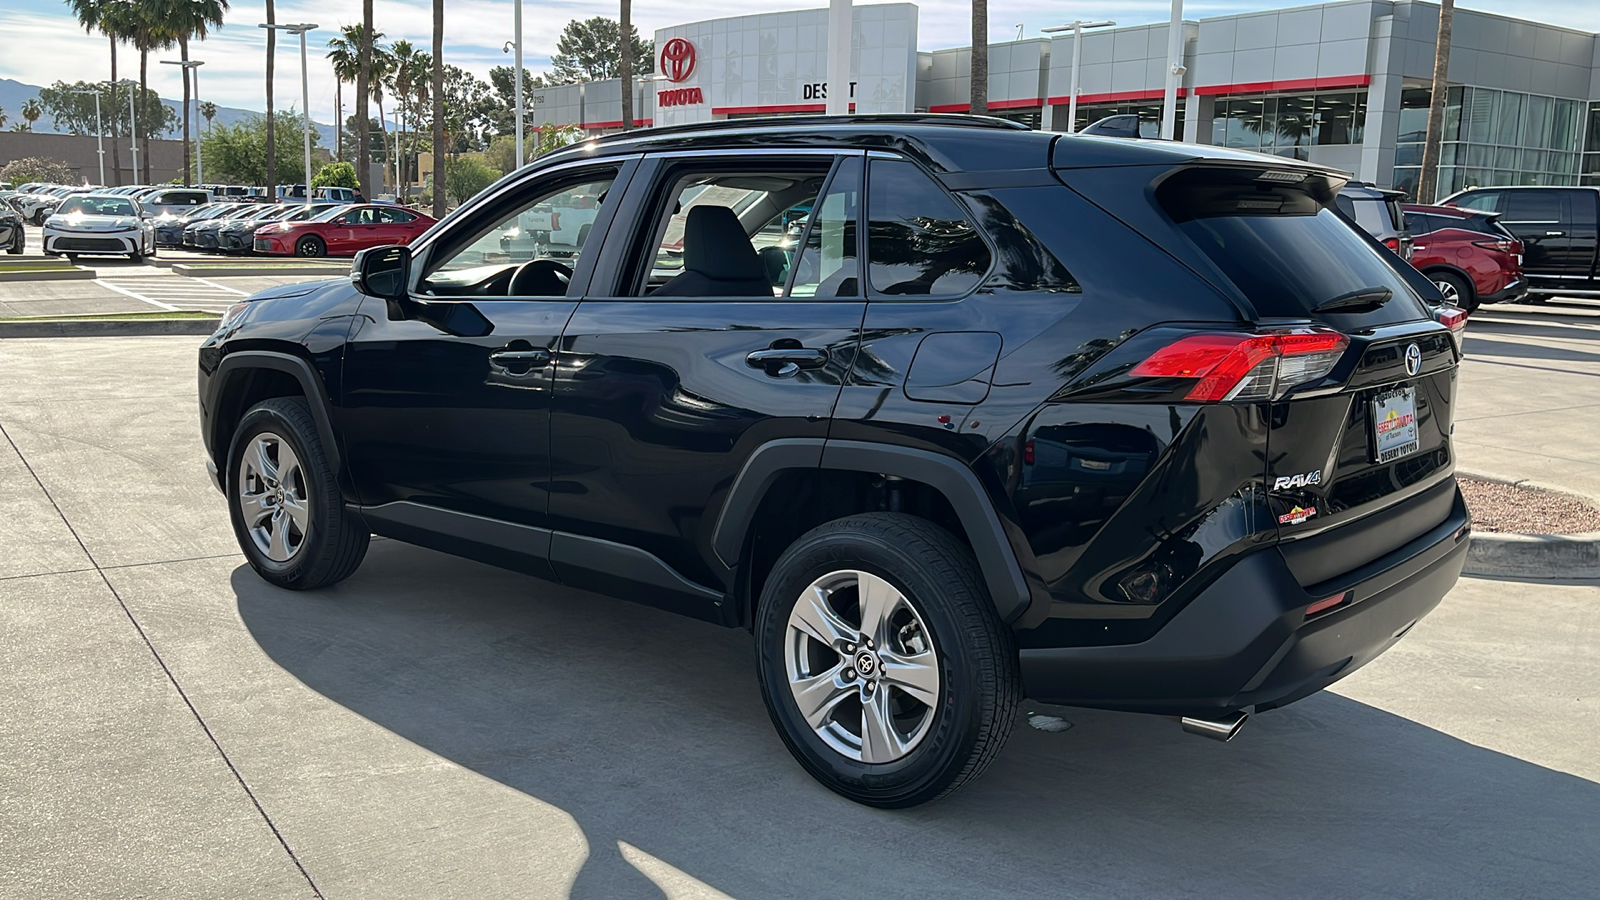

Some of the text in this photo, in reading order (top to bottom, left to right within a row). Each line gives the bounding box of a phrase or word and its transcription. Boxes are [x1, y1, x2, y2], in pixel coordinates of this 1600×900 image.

[658, 88, 703, 107] TOYOTA
[803, 82, 857, 99] DEST
[1381, 441, 1417, 462] DESERT TOYOTA
[1273, 470, 1321, 491] RAV4
